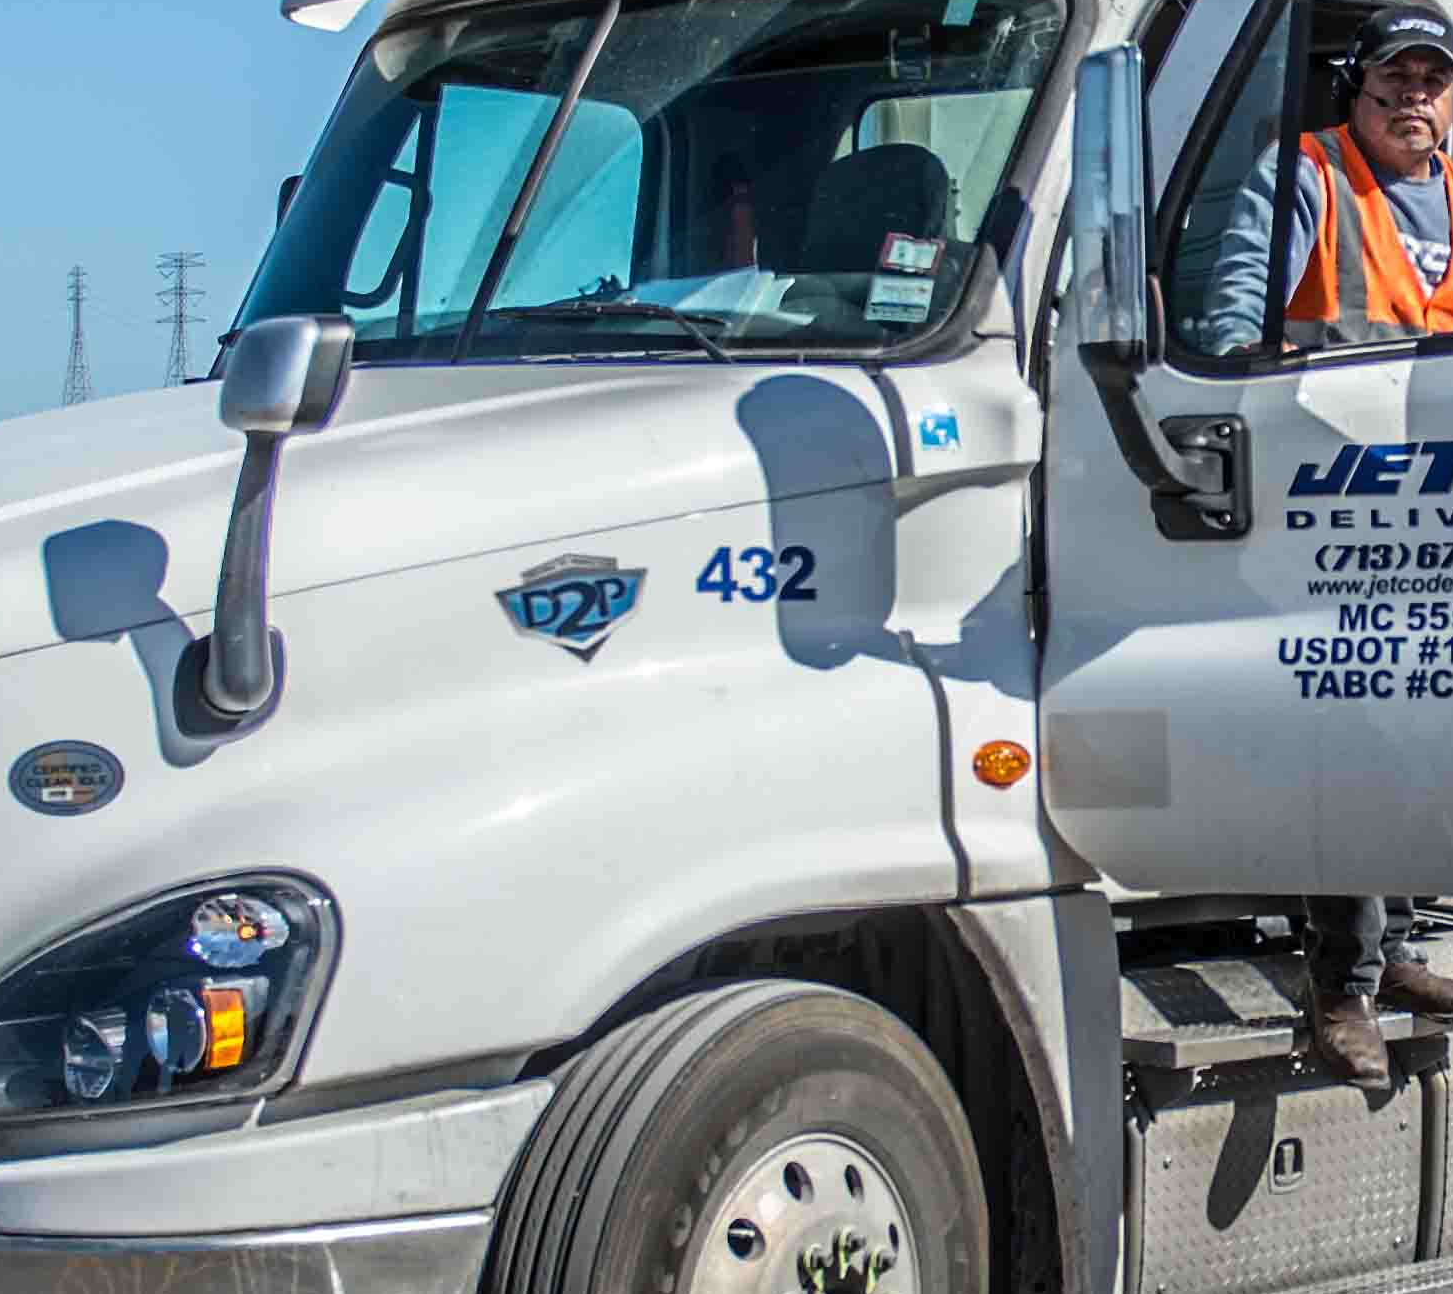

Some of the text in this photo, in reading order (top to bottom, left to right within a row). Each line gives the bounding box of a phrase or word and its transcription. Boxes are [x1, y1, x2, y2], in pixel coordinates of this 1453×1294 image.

[696, 546, 818, 602] 432
[522, 578, 627, 637] D2P
[1338, 604, 1395, 632] MC
[1278, 637, 1409, 665] USDOT
[1294, 669, 1395, 698] TABC
